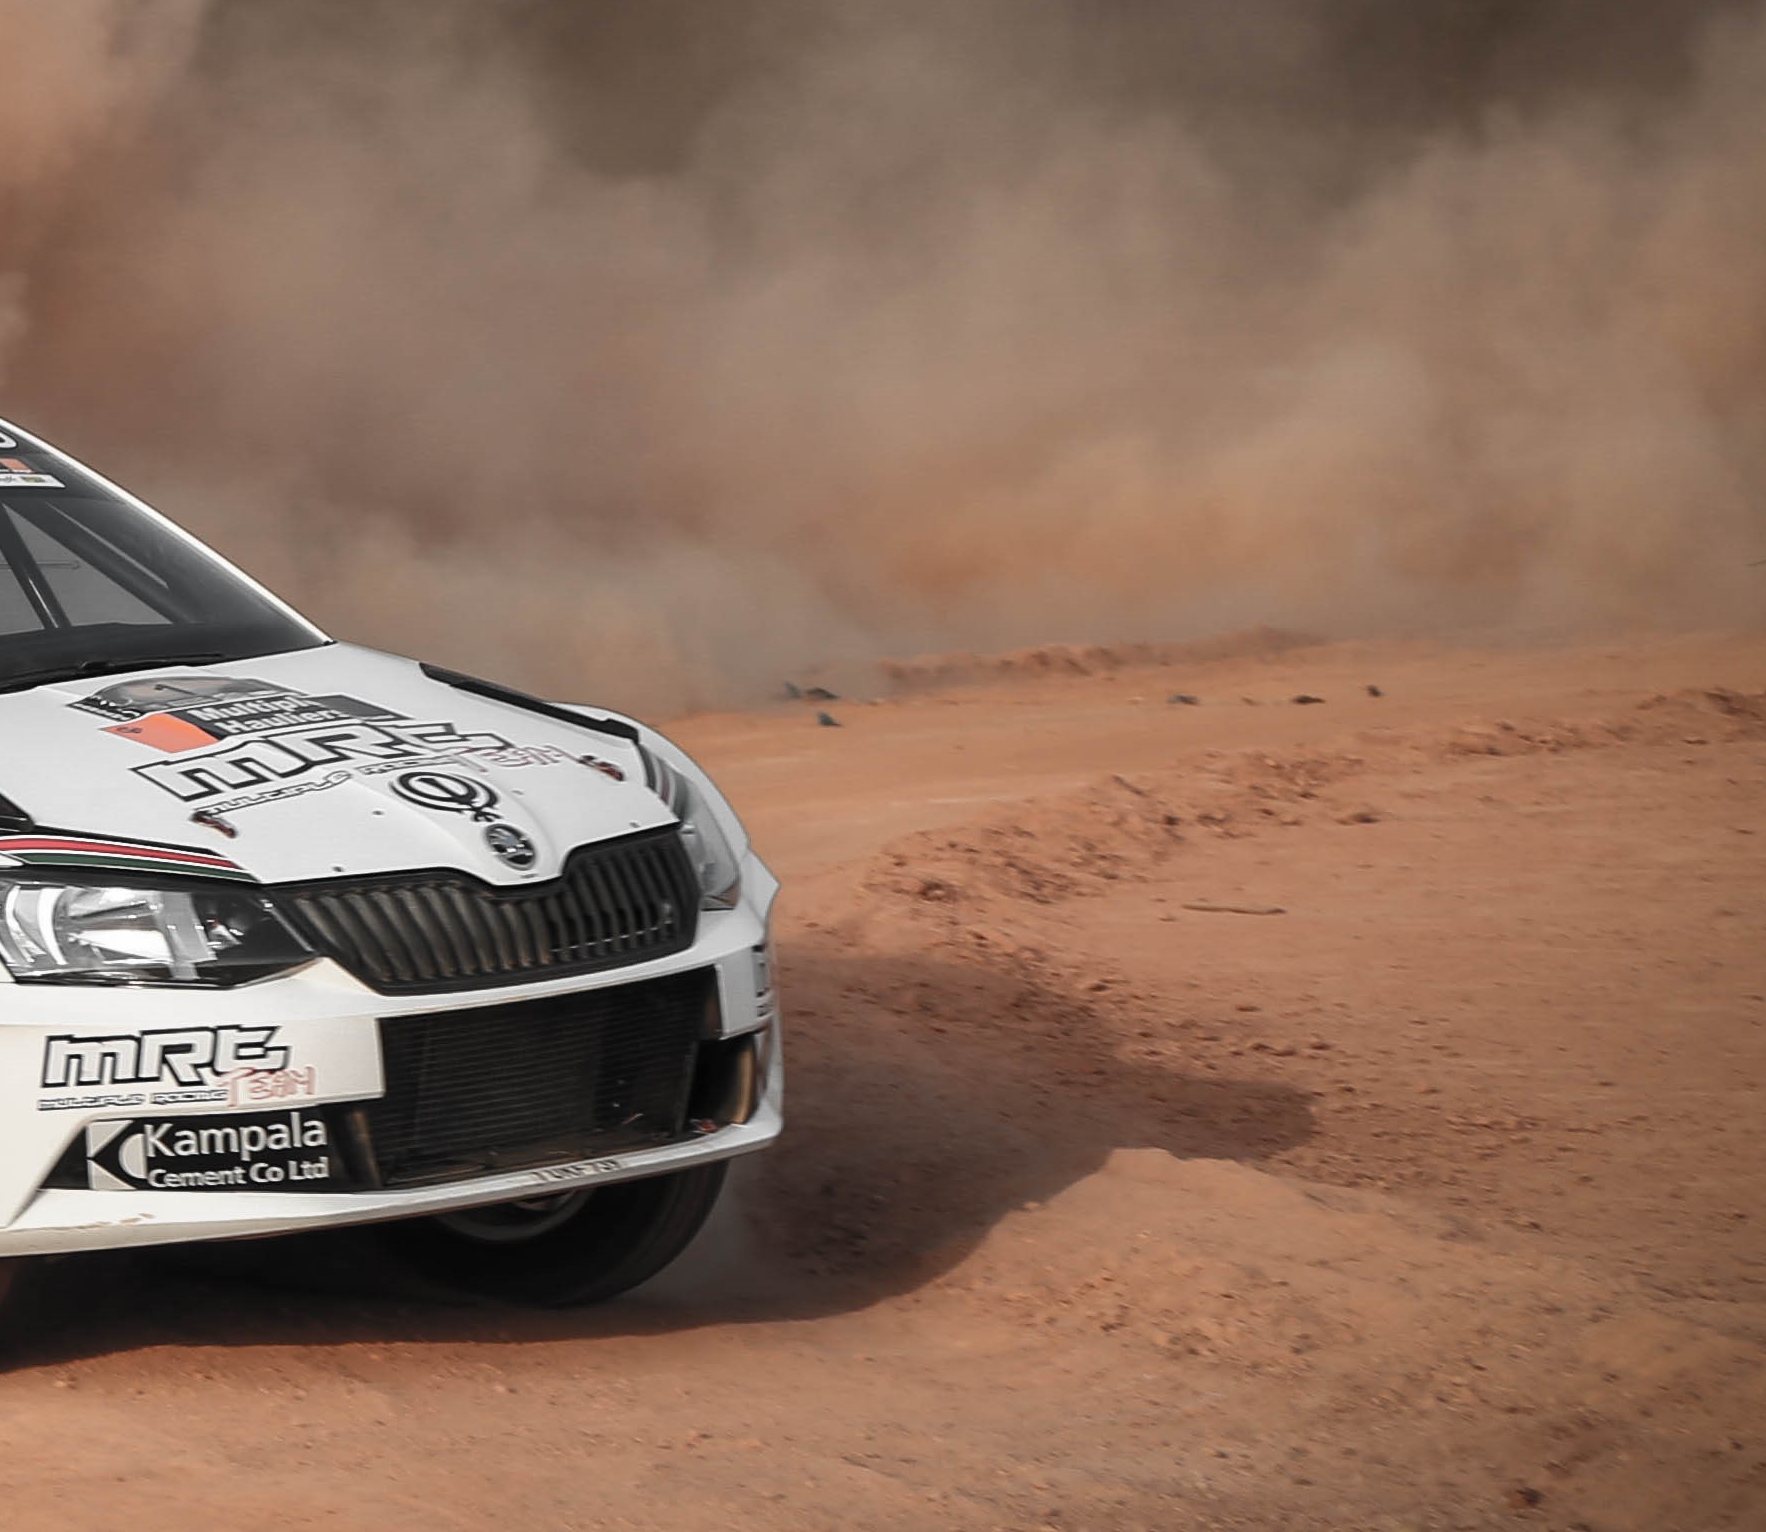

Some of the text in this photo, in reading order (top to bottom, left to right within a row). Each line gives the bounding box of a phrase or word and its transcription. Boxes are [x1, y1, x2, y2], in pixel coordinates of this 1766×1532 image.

[143, 1111, 328, 1161] Kampala
[147, 1156, 329, 1189] Cement Co Ltd
